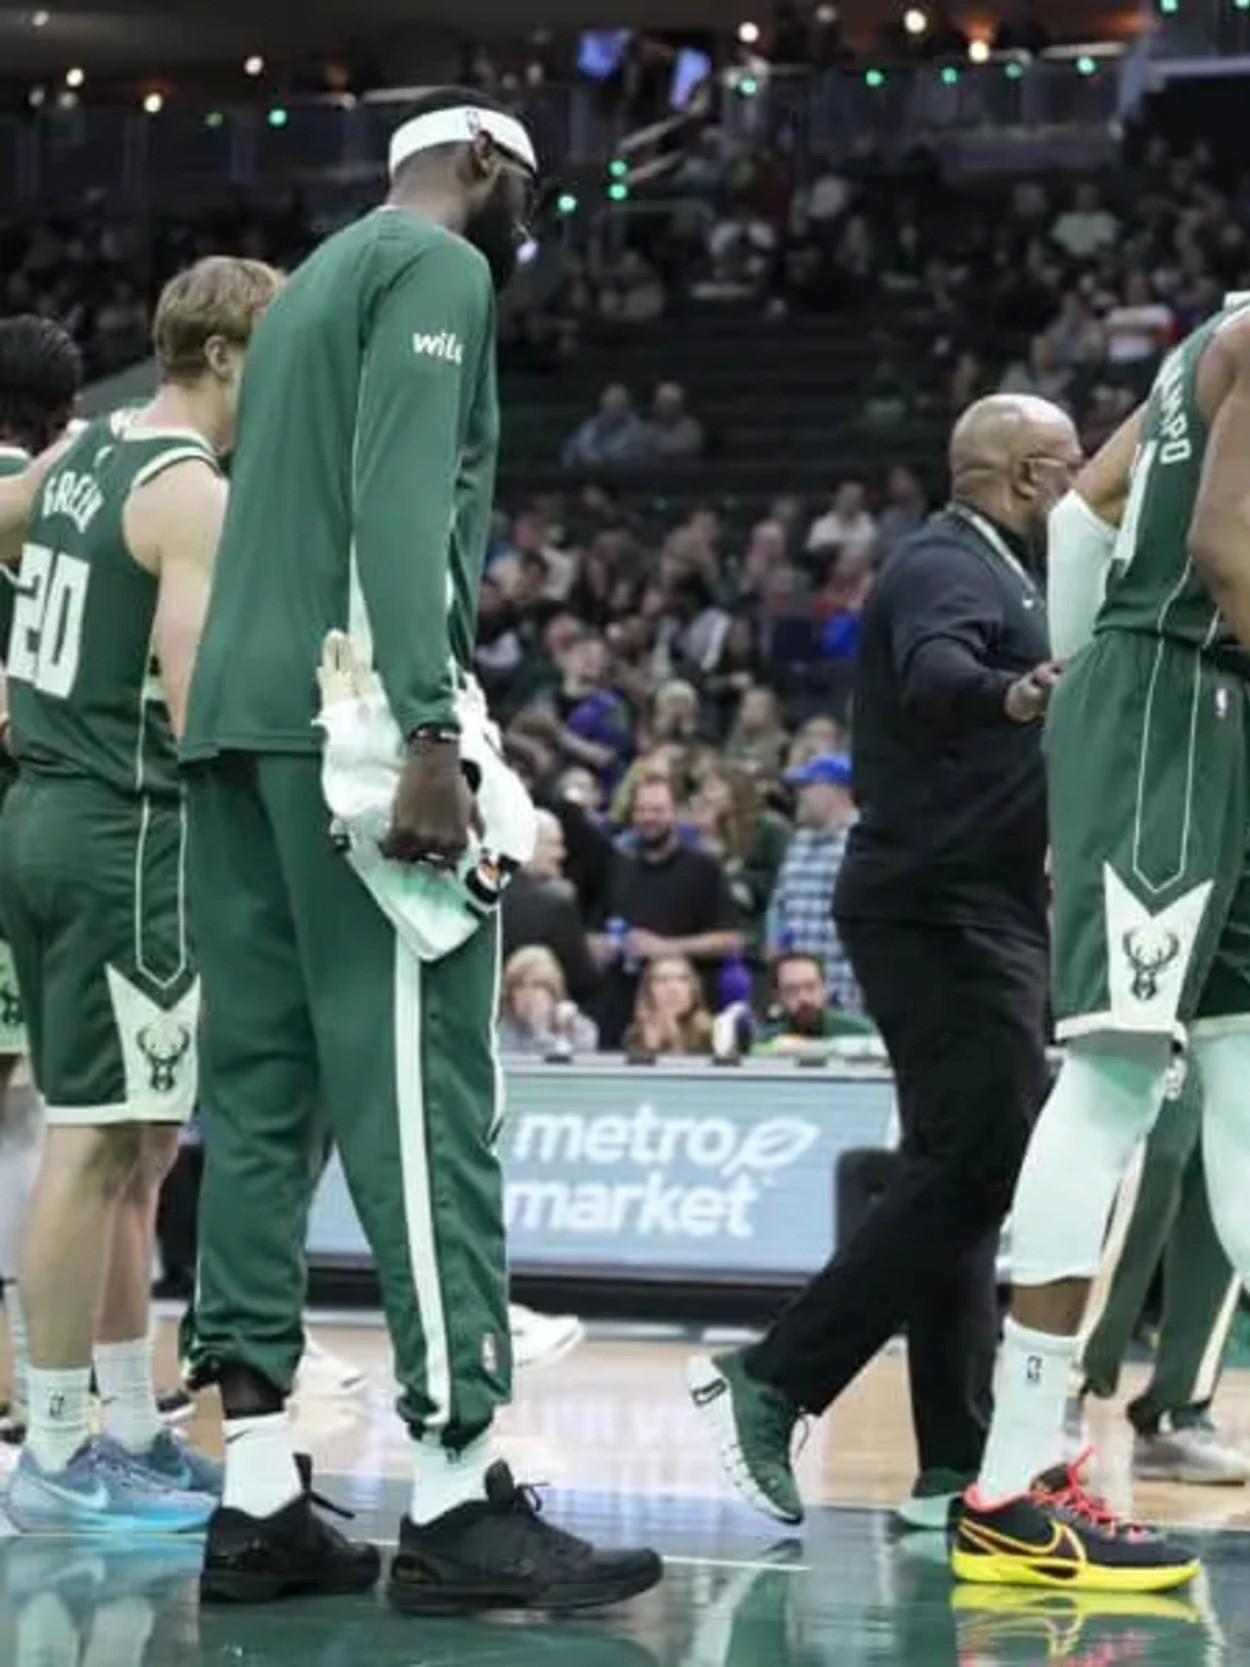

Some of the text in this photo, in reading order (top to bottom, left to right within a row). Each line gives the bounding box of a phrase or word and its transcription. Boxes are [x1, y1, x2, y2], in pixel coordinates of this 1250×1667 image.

[7, 543, 90, 699] 20
[513, 1101, 736, 1166] metro
[504, 1171, 757, 1237] market
